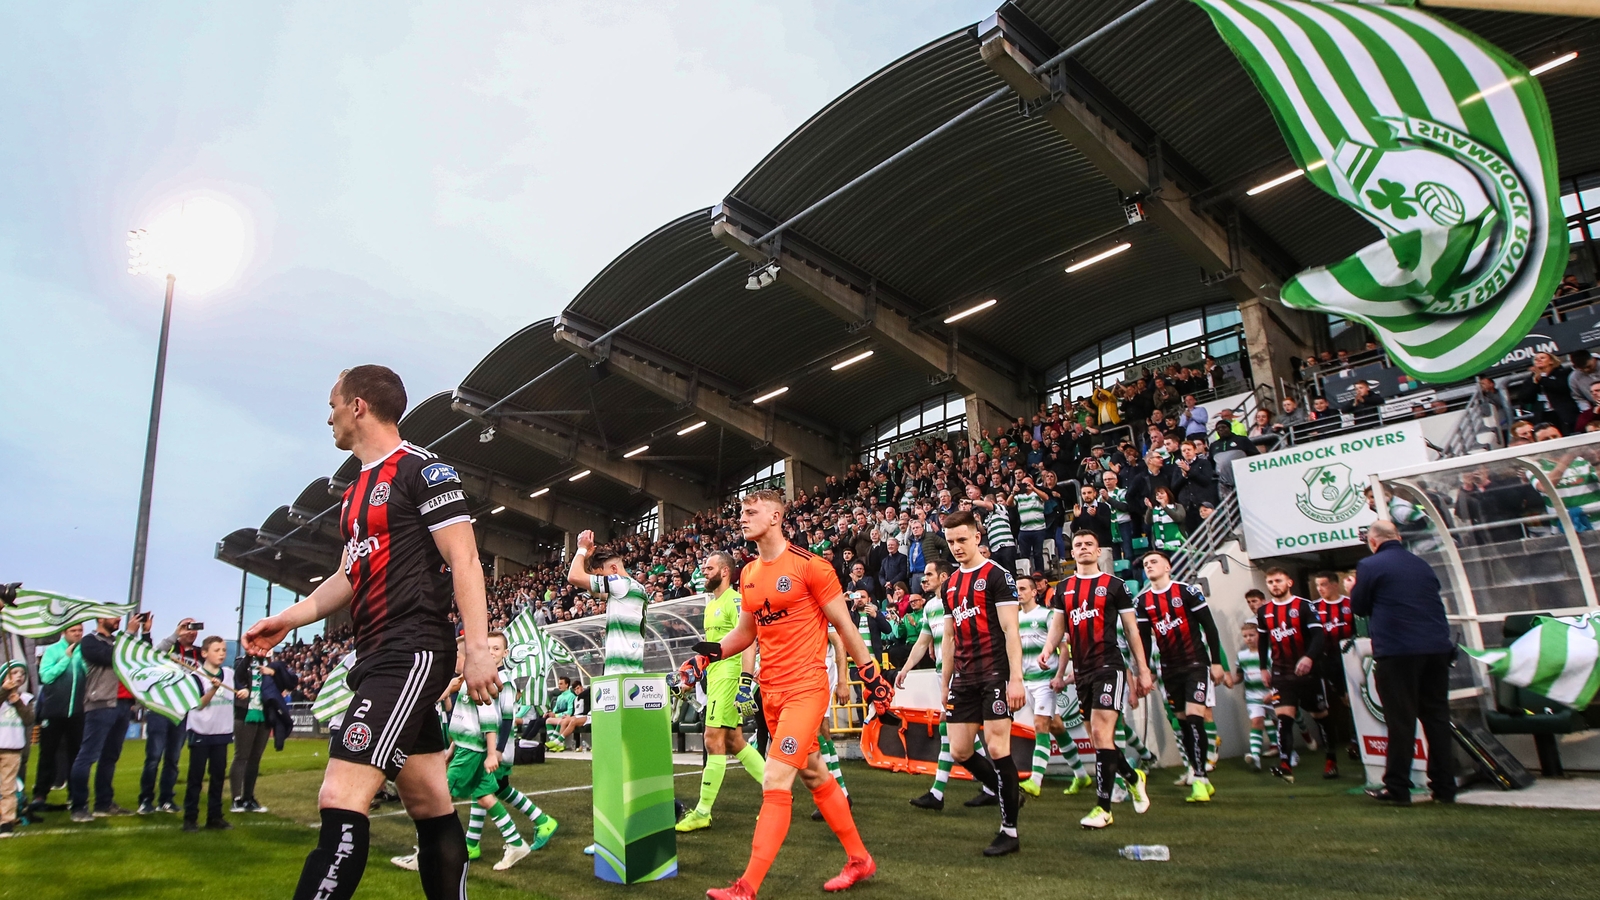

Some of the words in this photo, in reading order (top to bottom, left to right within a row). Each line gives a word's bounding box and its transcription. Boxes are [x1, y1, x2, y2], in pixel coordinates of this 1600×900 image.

[1491, 340, 1559, 367] TADIUM
[1248, 446, 1337, 473] SHAMROCK
[1340, 430, 1406, 454] ROVERS
[428, 491, 459, 509] CAPTAIN
[1276, 528, 1359, 549] FOOTBALL
[1073, 609, 1100, 626] green
[993, 688, 1001, 699] 3
[1103, 683, 1113, 693] 18
[1196, 682, 1206, 691] 12
[641, 692, 663, 701] Airtricity
[353, 698, 372, 719] 2
[711, 699, 717, 716] 1
